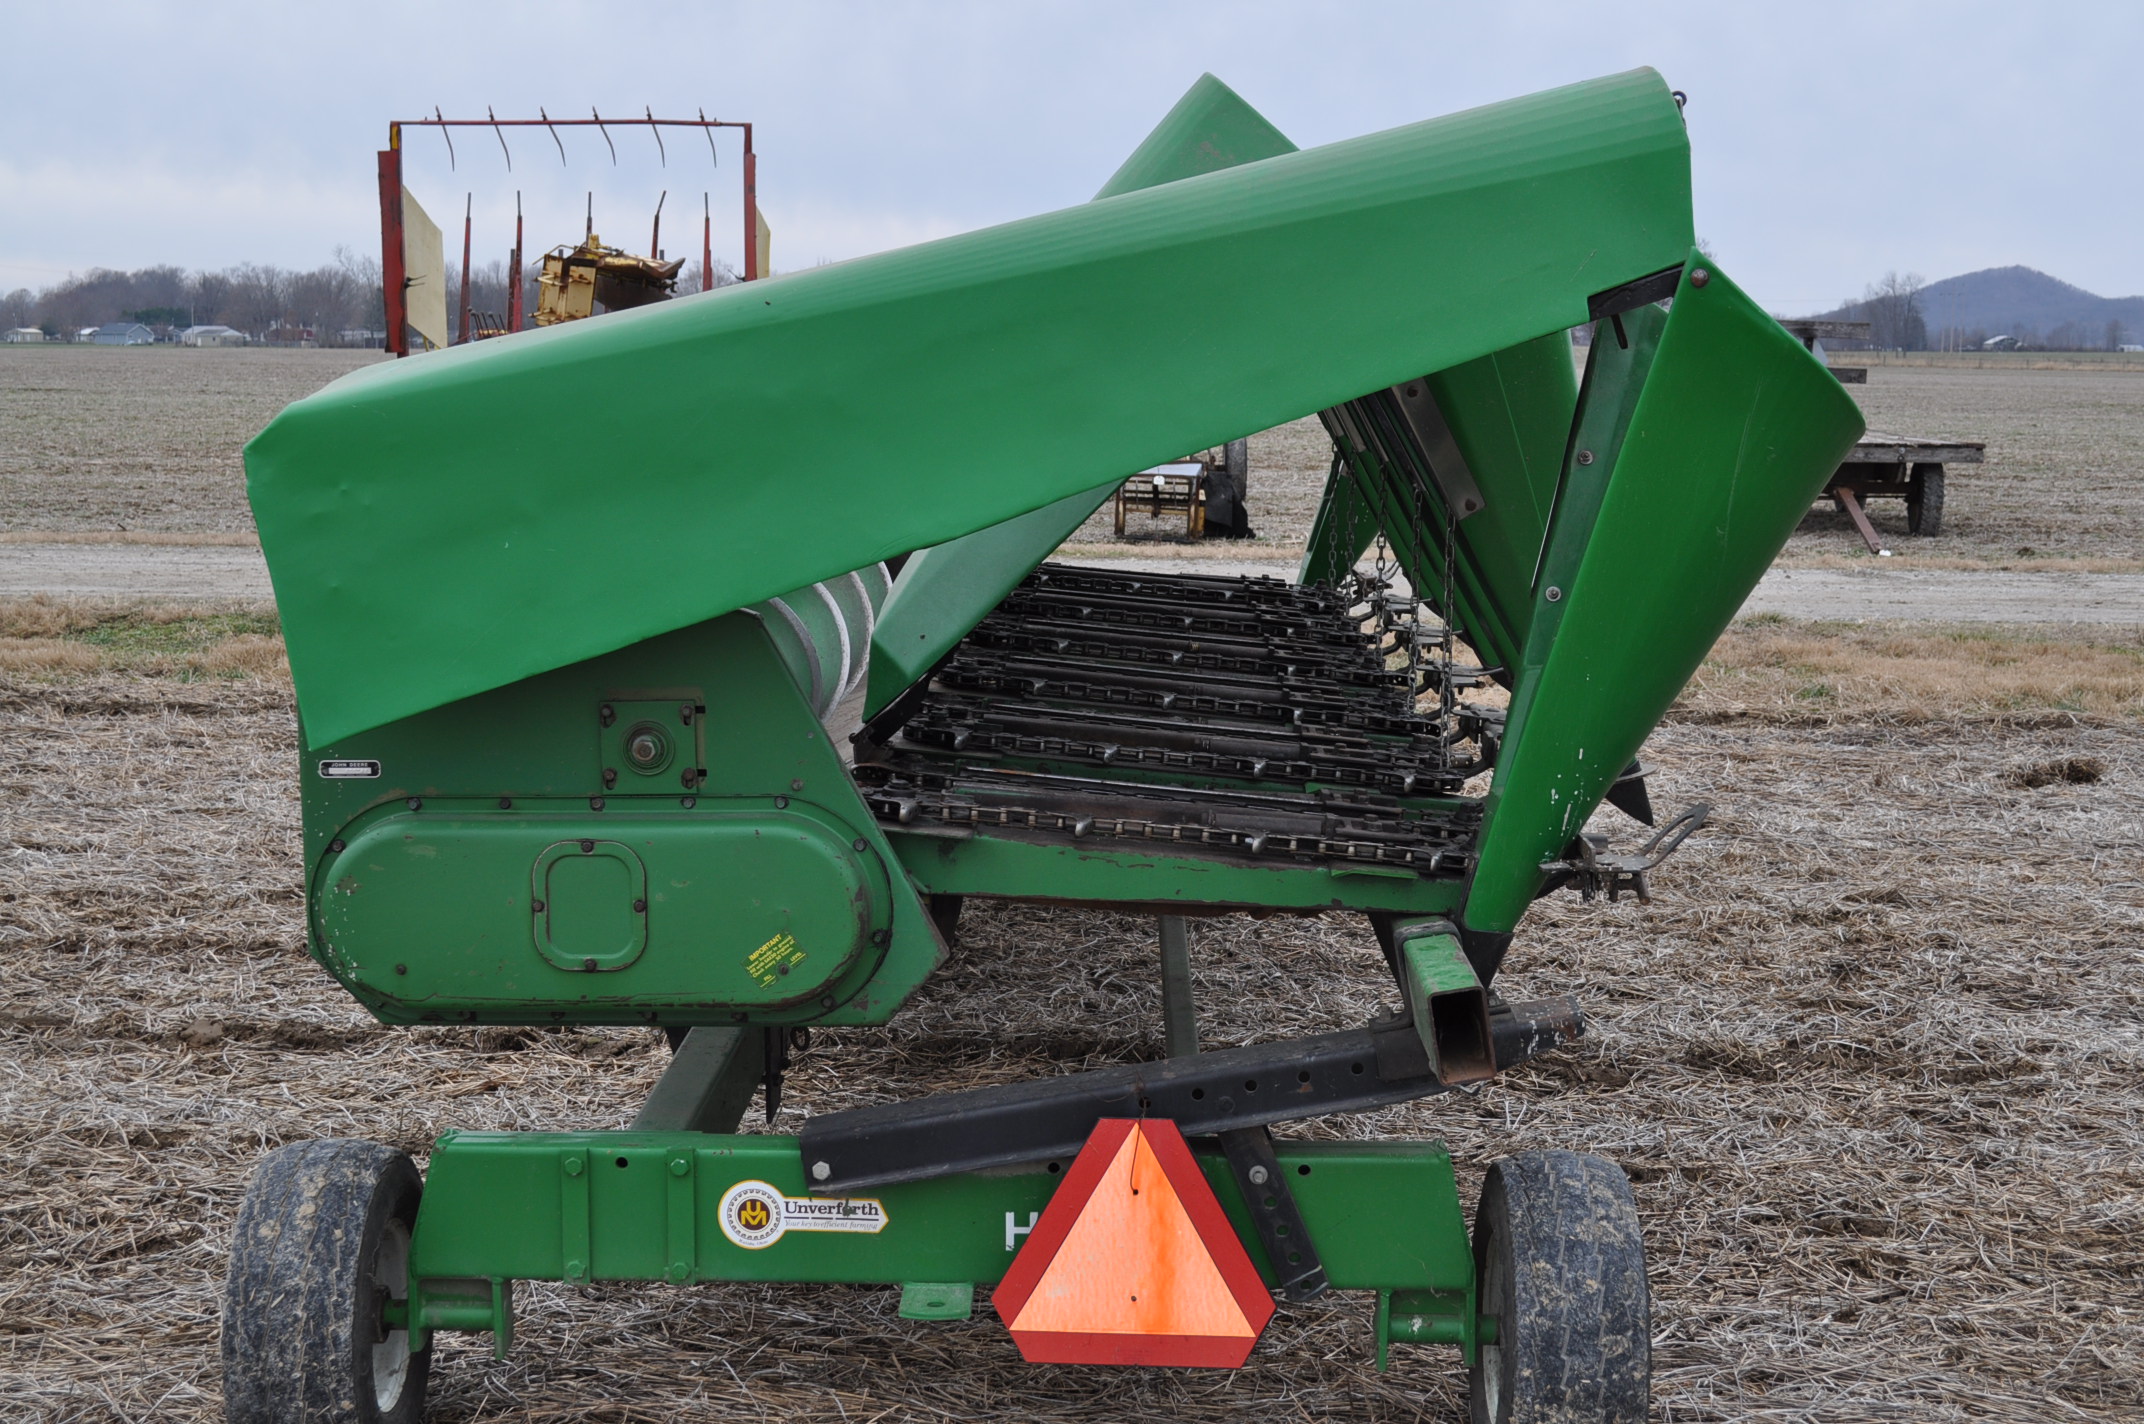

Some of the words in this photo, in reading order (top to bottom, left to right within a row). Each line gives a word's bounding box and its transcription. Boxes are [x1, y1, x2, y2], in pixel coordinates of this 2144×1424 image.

[748, 933, 782, 961] IMPORTANT
[790, 952, 802, 962] LEVEL
[801, 1220, 812, 1228] key
